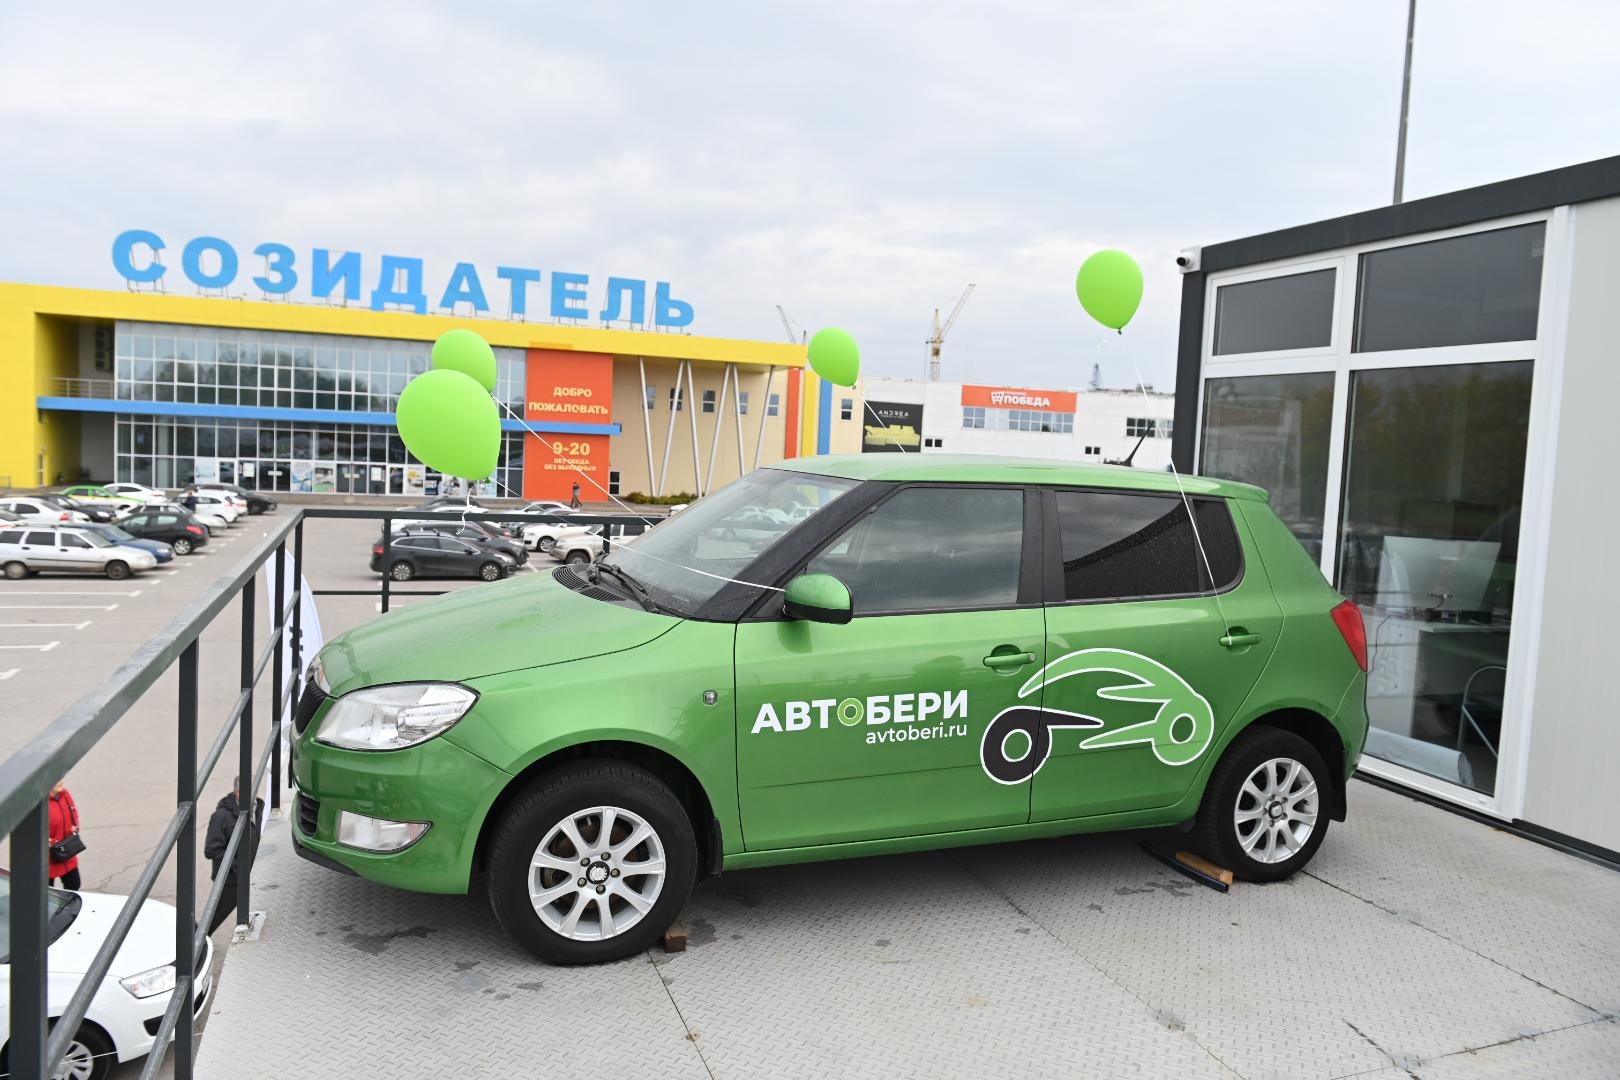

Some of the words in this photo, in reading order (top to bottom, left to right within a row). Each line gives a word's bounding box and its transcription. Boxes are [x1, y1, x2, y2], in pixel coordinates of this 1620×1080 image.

[111, 229, 694, 328] СОЗИДАТЕЛЬ
[553, 387, 592, 398] ДОБРО
[1004, 395, 1050, 407] ПОБЕДА
[528, 402, 609, 415] ПОЖАЛОВАТЬ
[553, 442, 590, 456] 9-20
[751, 690, 968, 734] АВТОБЕРИ
[866, 722, 967, 744] avtoberi.ru
